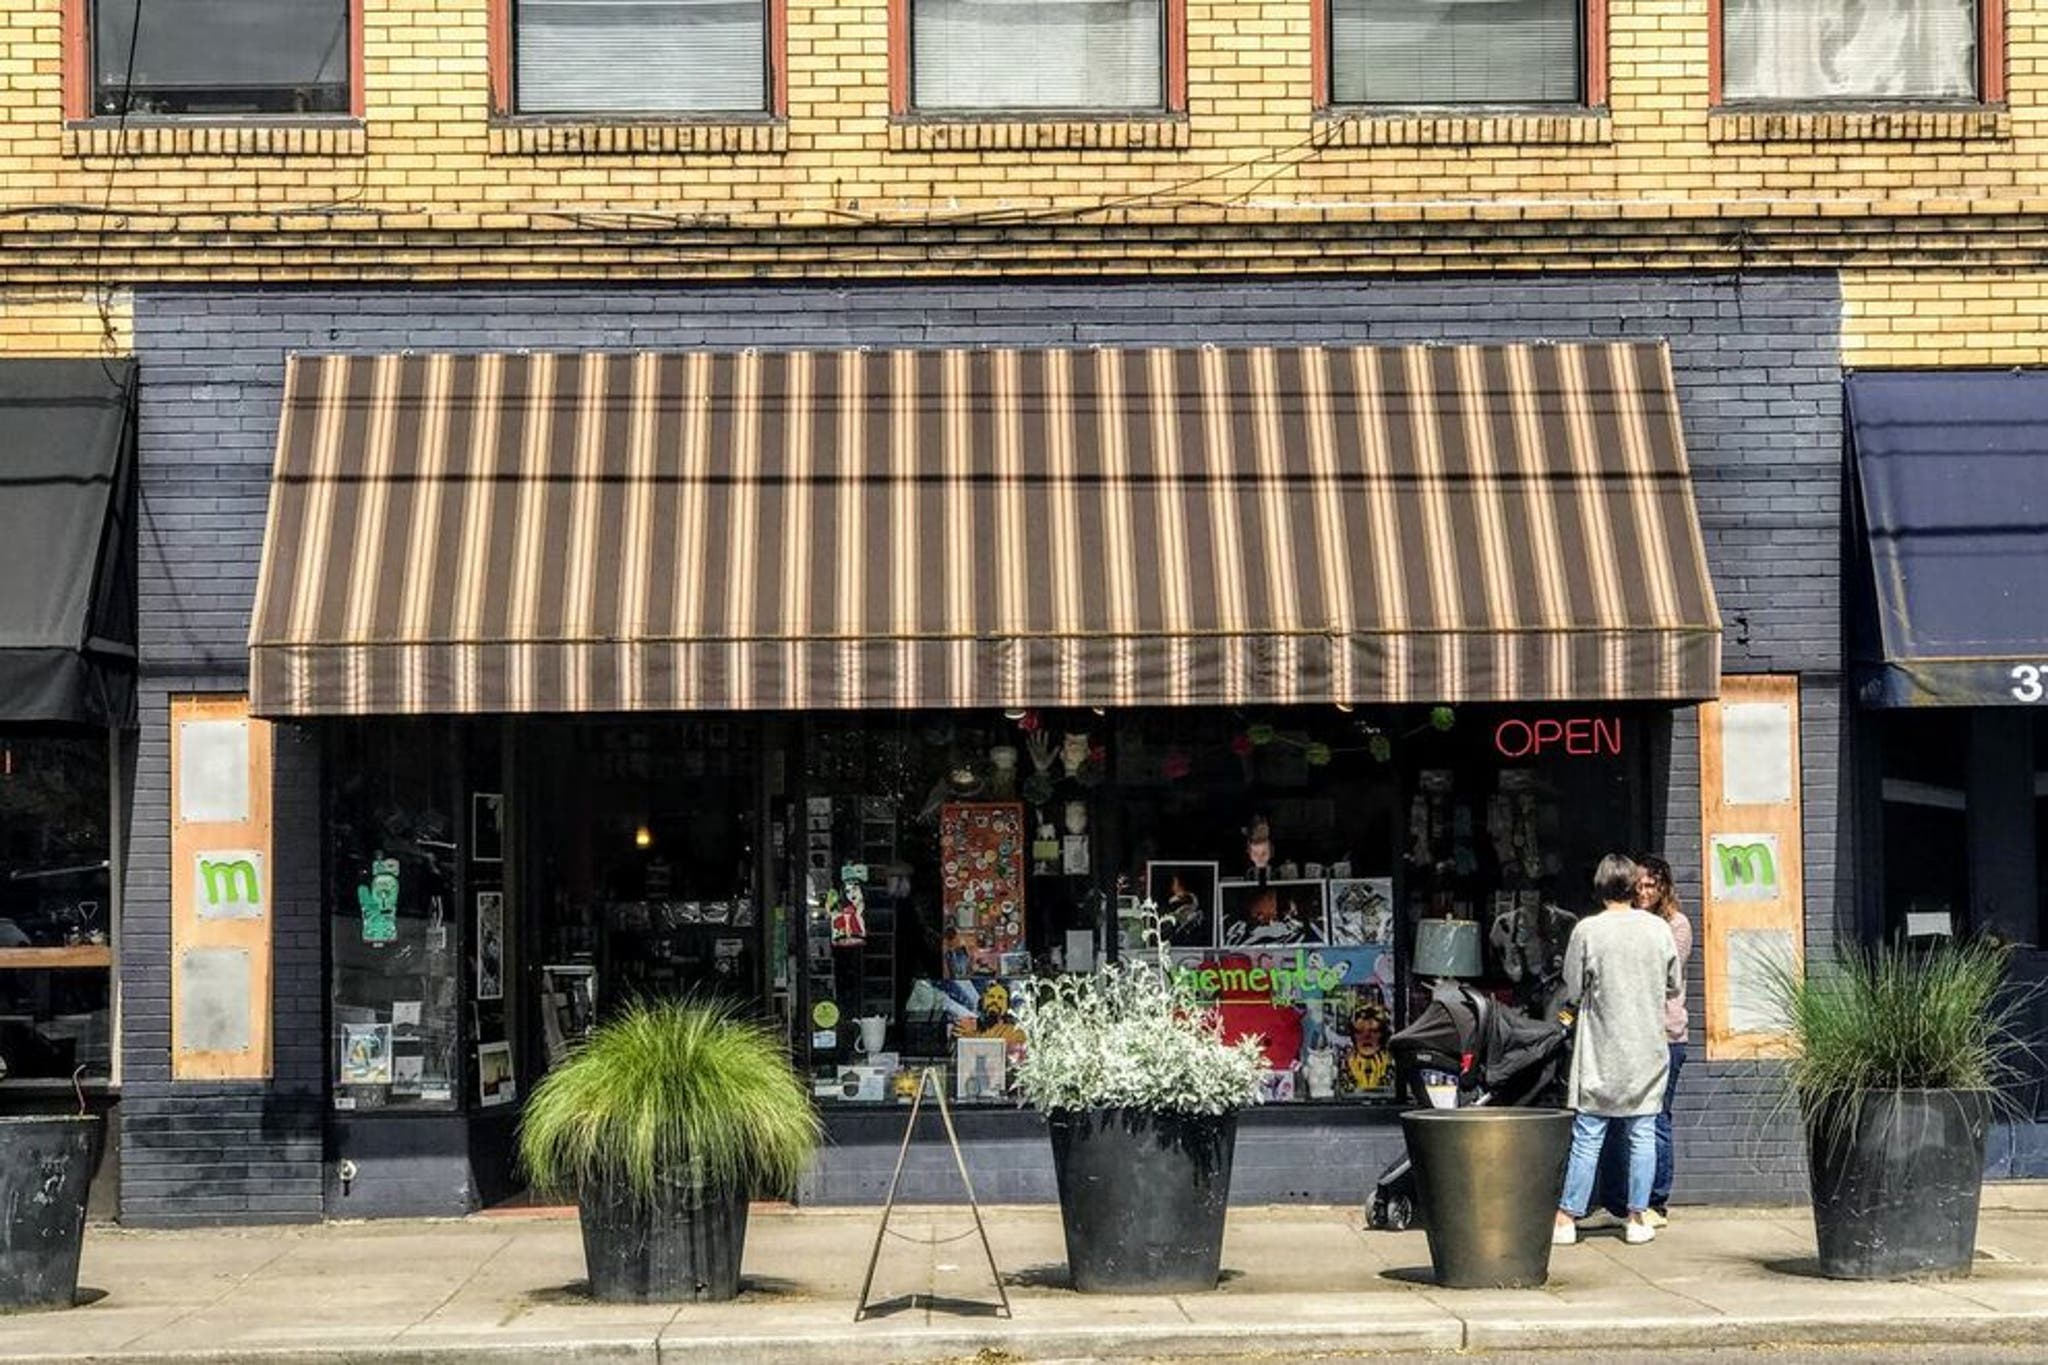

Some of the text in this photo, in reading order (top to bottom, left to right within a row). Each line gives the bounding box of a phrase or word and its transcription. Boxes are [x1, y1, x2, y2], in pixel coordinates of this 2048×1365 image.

[2012, 664, 2048, 702] 3
[1495, 718, 1621, 757] OPEN
[200, 859, 260, 905] m
[1716, 843, 1775, 887] m
